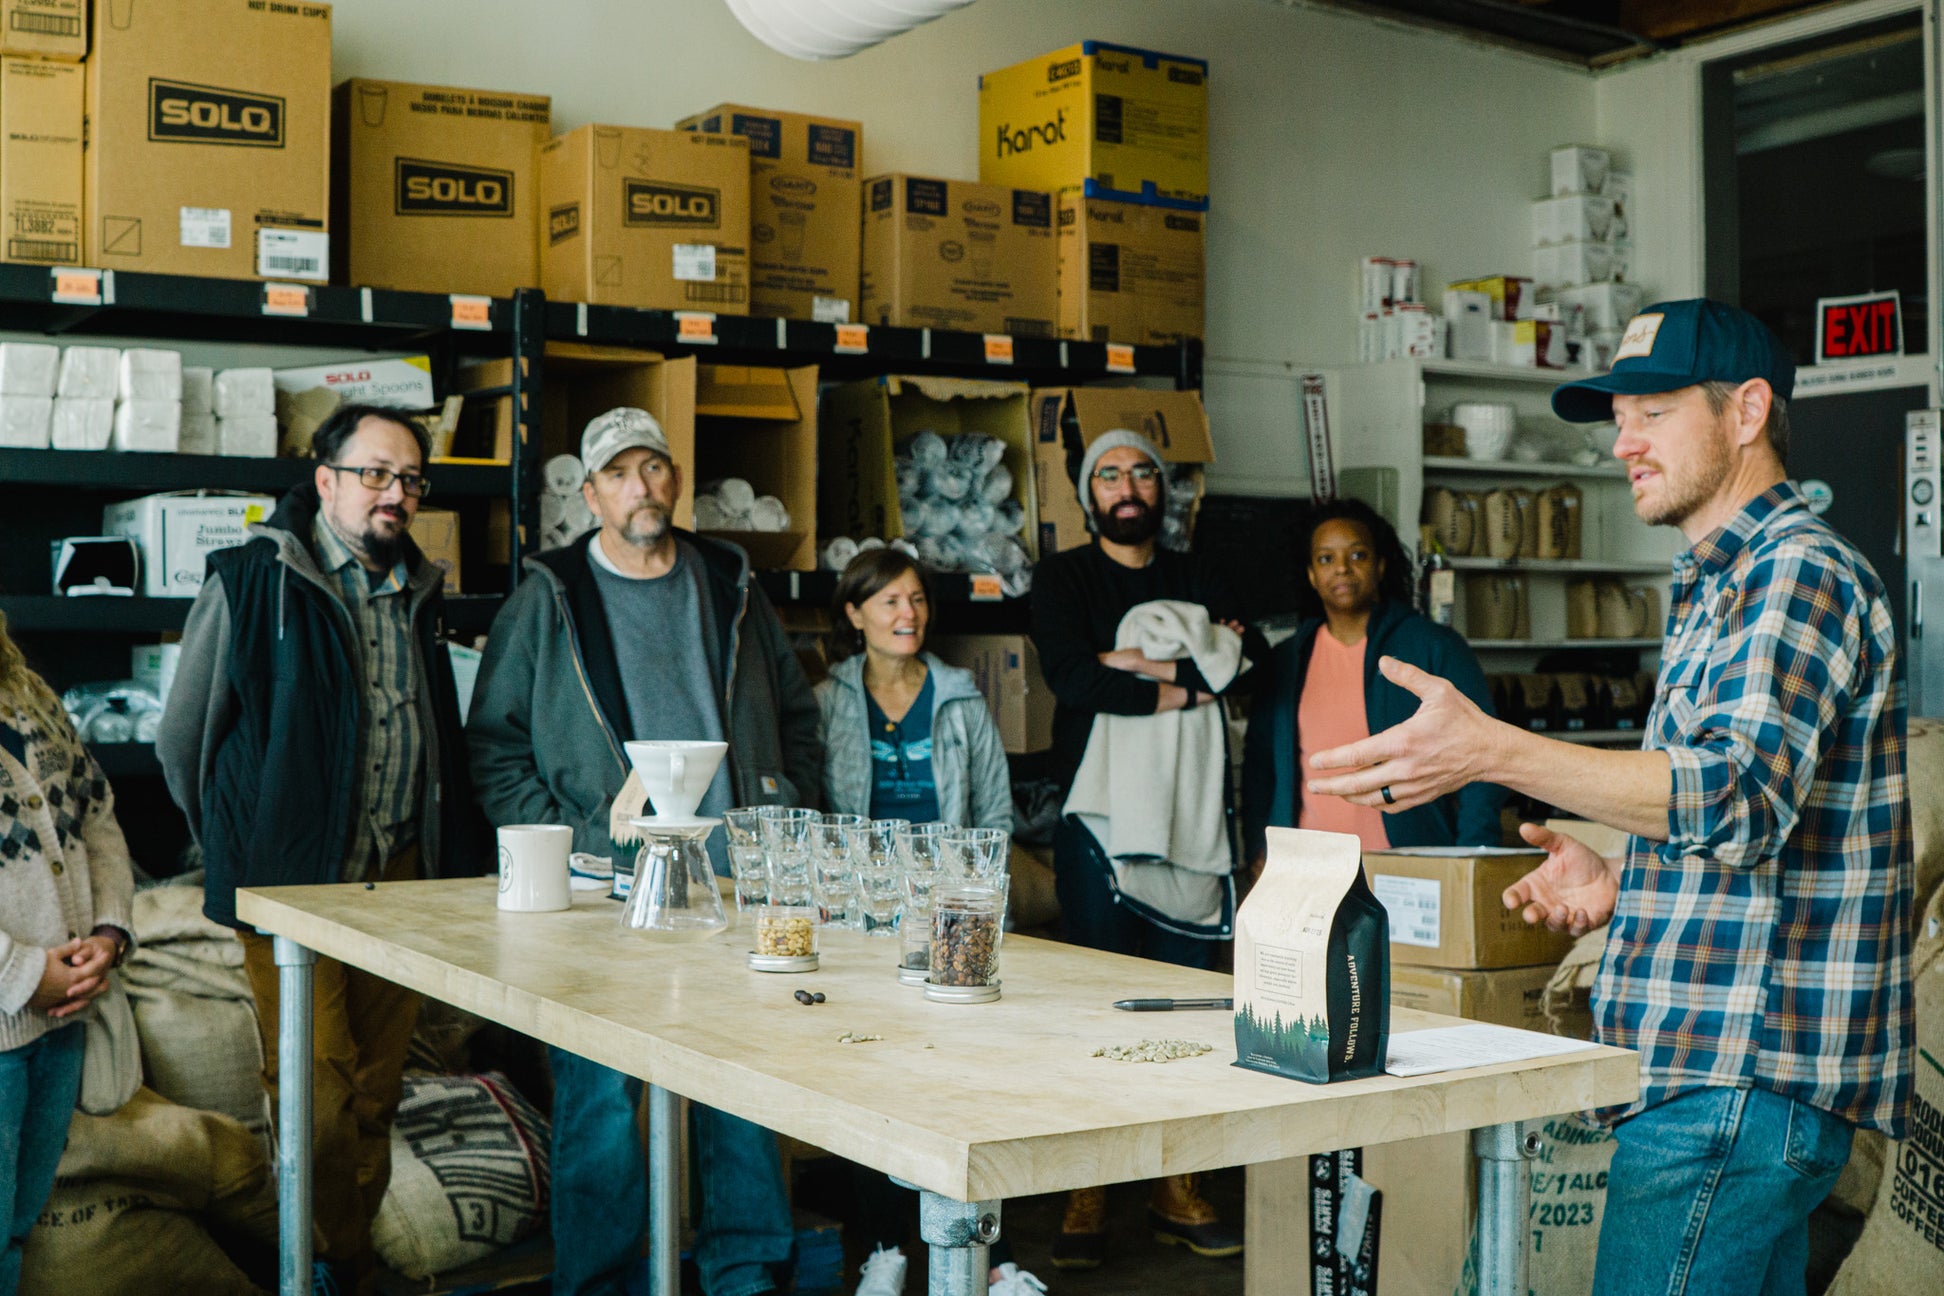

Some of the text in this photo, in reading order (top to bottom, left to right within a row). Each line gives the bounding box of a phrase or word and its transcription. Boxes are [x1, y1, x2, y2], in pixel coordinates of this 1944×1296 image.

[161, 98, 271, 133] SOLO
[997, 109, 1067, 159] Karat
[406, 176, 503, 205] SOLO
[632, 193, 711, 218] SOLO
[1826, 301, 1895, 356] EXIT
[325, 370, 371, 385] SOLO
[371, 380, 423, 396] Spoons
[196, 523, 243, 534] Jumbo
[196, 535, 243, 546] Straws
[1343, 954, 1361, 1064] ADVENTURE FOLLOWS.
[1321, 1188, 1333, 1235] PARTS
